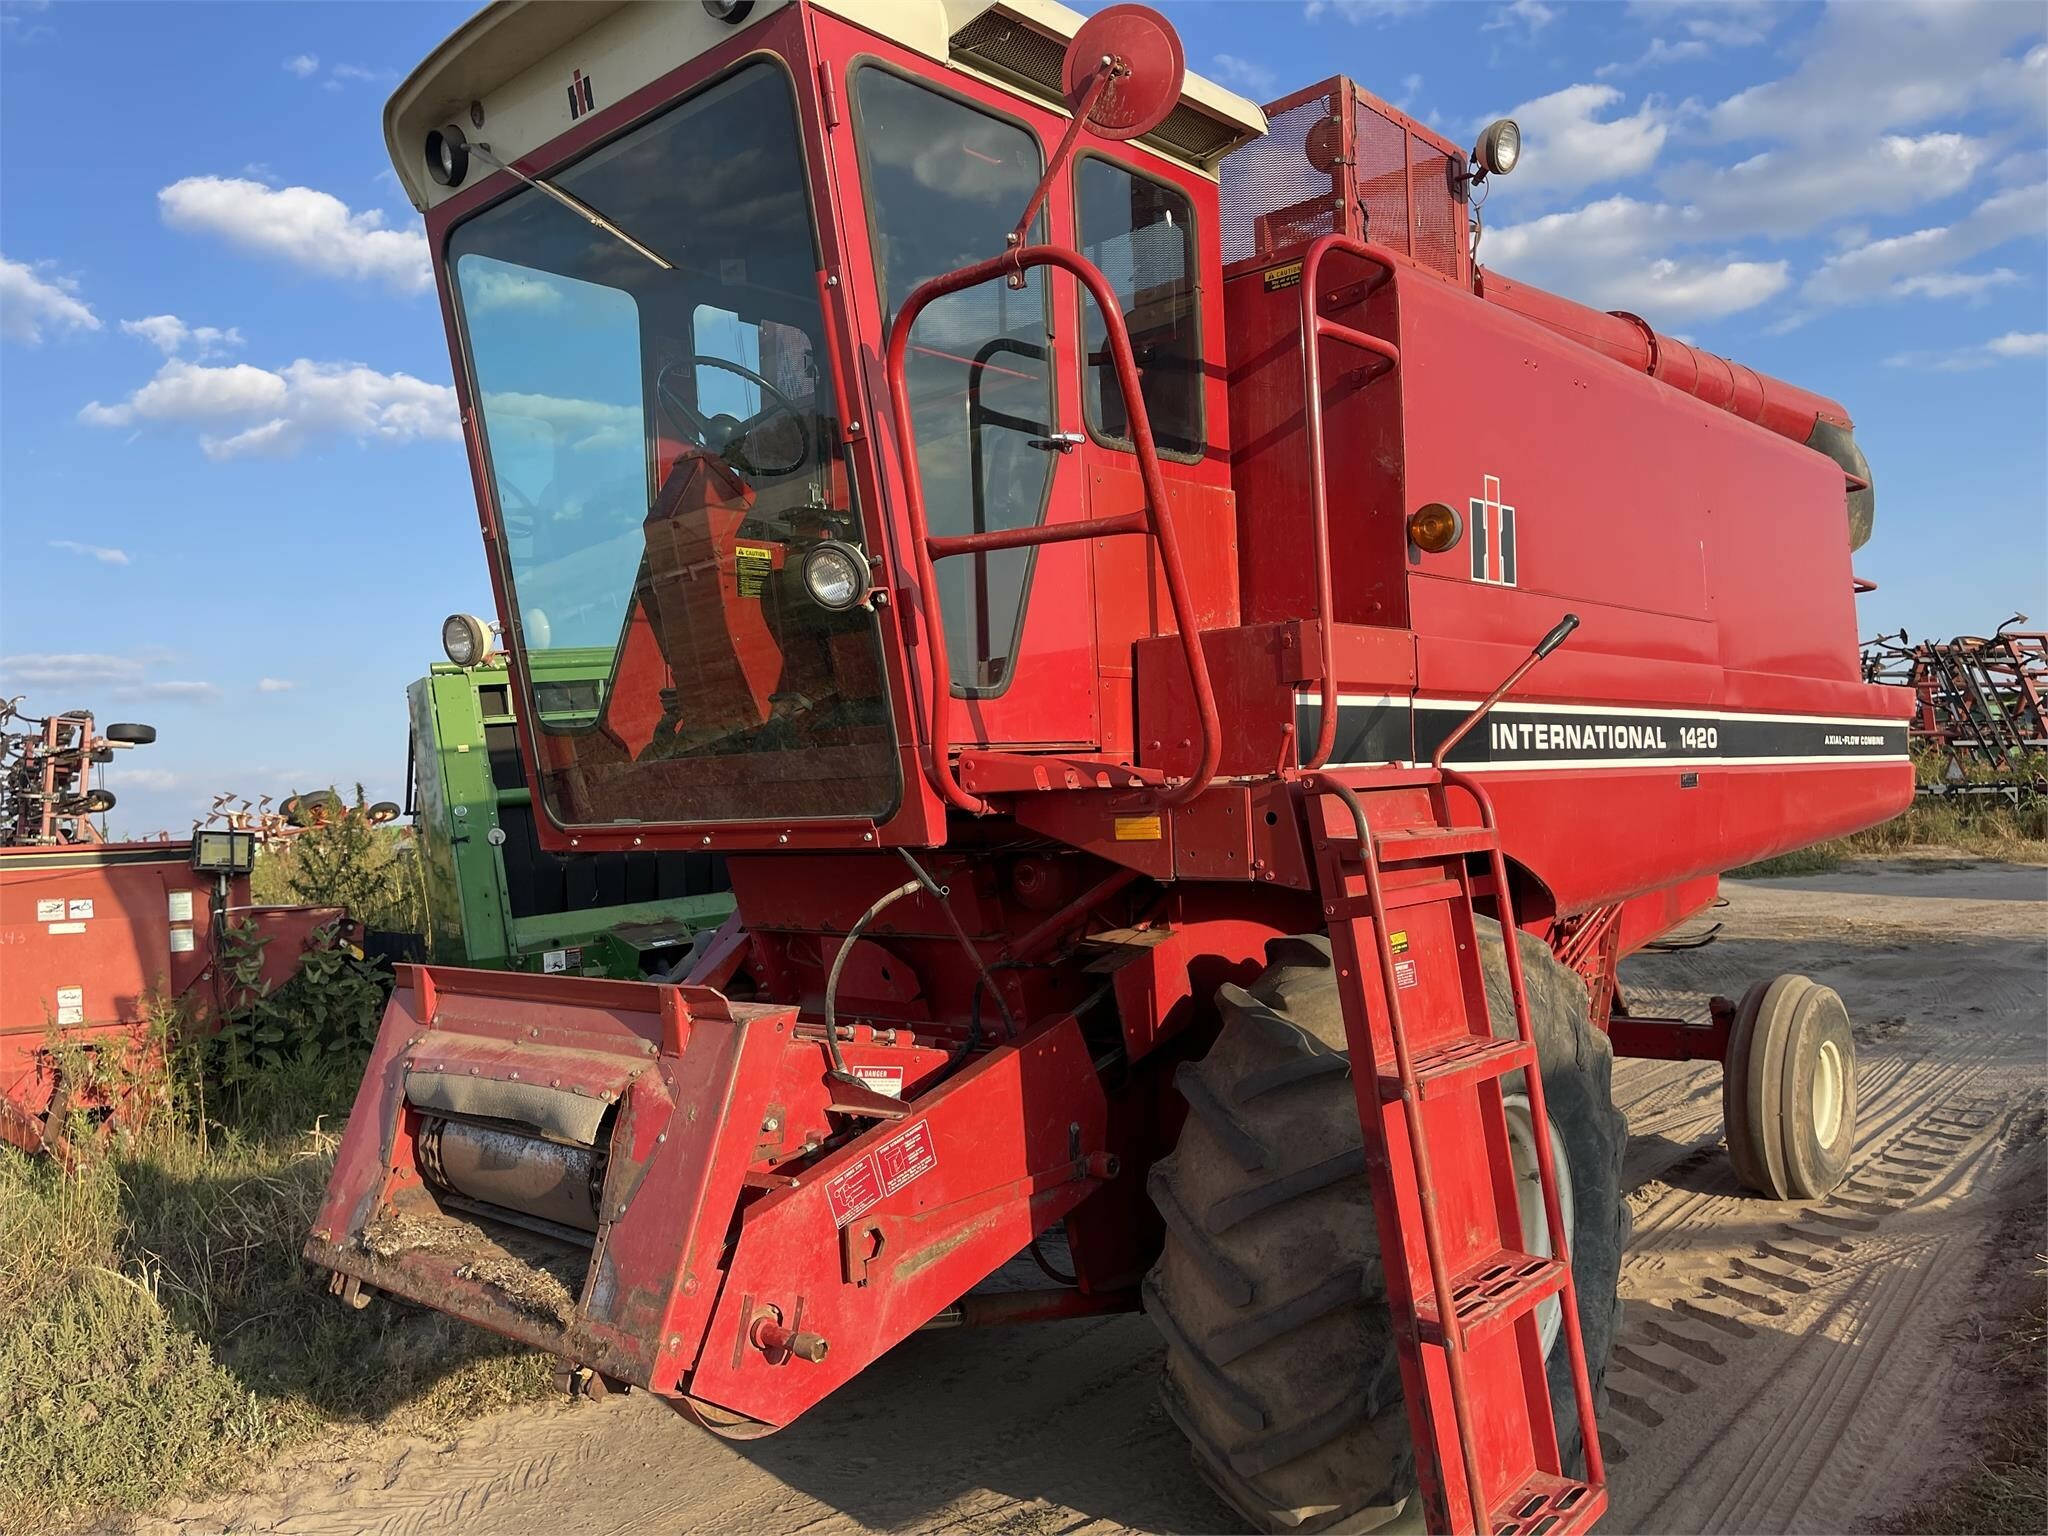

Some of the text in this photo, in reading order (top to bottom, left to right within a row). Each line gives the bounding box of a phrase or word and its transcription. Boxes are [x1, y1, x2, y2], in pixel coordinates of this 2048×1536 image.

[1491, 723, 1718, 750] INTERNATIONAL 1420
[1860, 736, 1885, 746] COMBINE
[864, 1069, 887, 1078] DANGER
